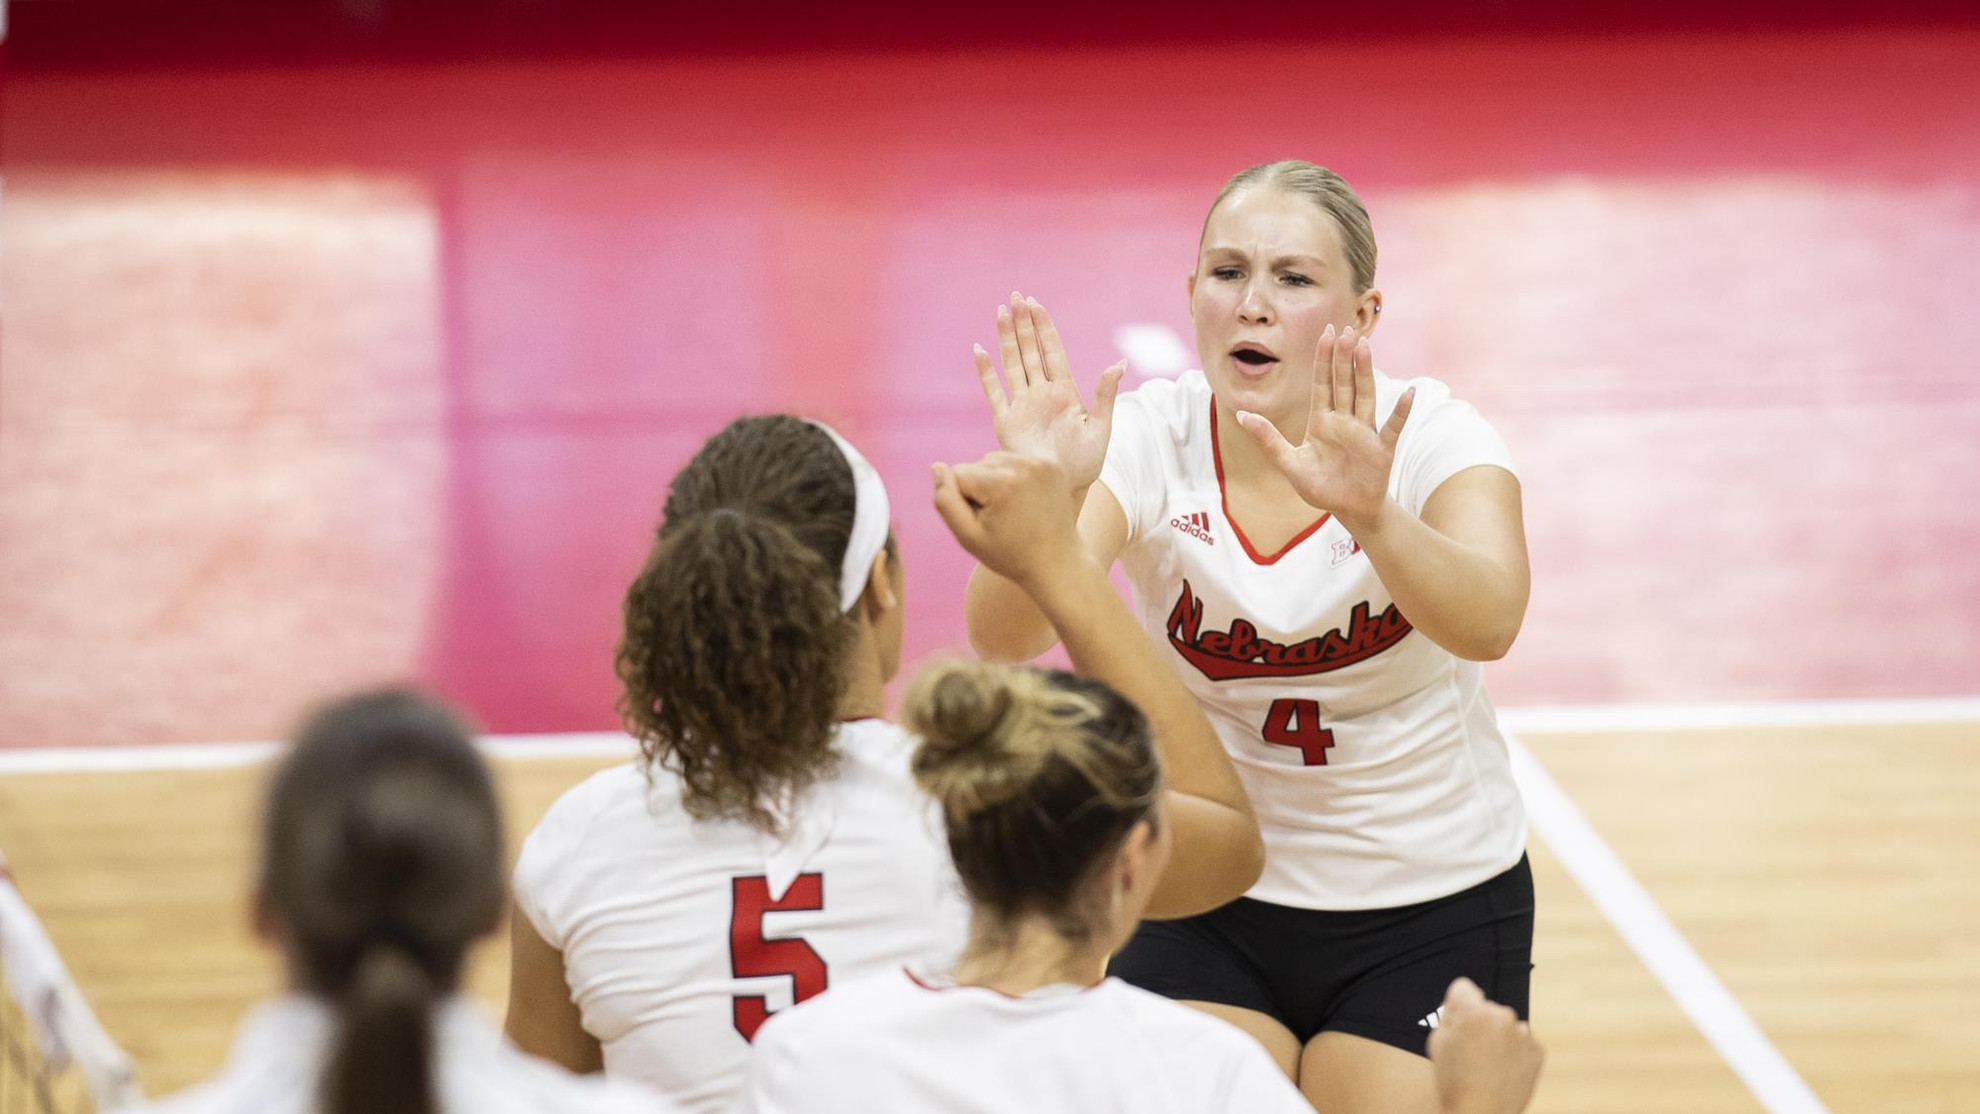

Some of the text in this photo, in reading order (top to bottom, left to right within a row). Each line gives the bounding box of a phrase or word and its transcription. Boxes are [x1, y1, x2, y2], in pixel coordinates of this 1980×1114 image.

[1170, 518, 1215, 546] adidas
[1261, 698, 1335, 766] 4
[730, 872, 828, 1045] 5
